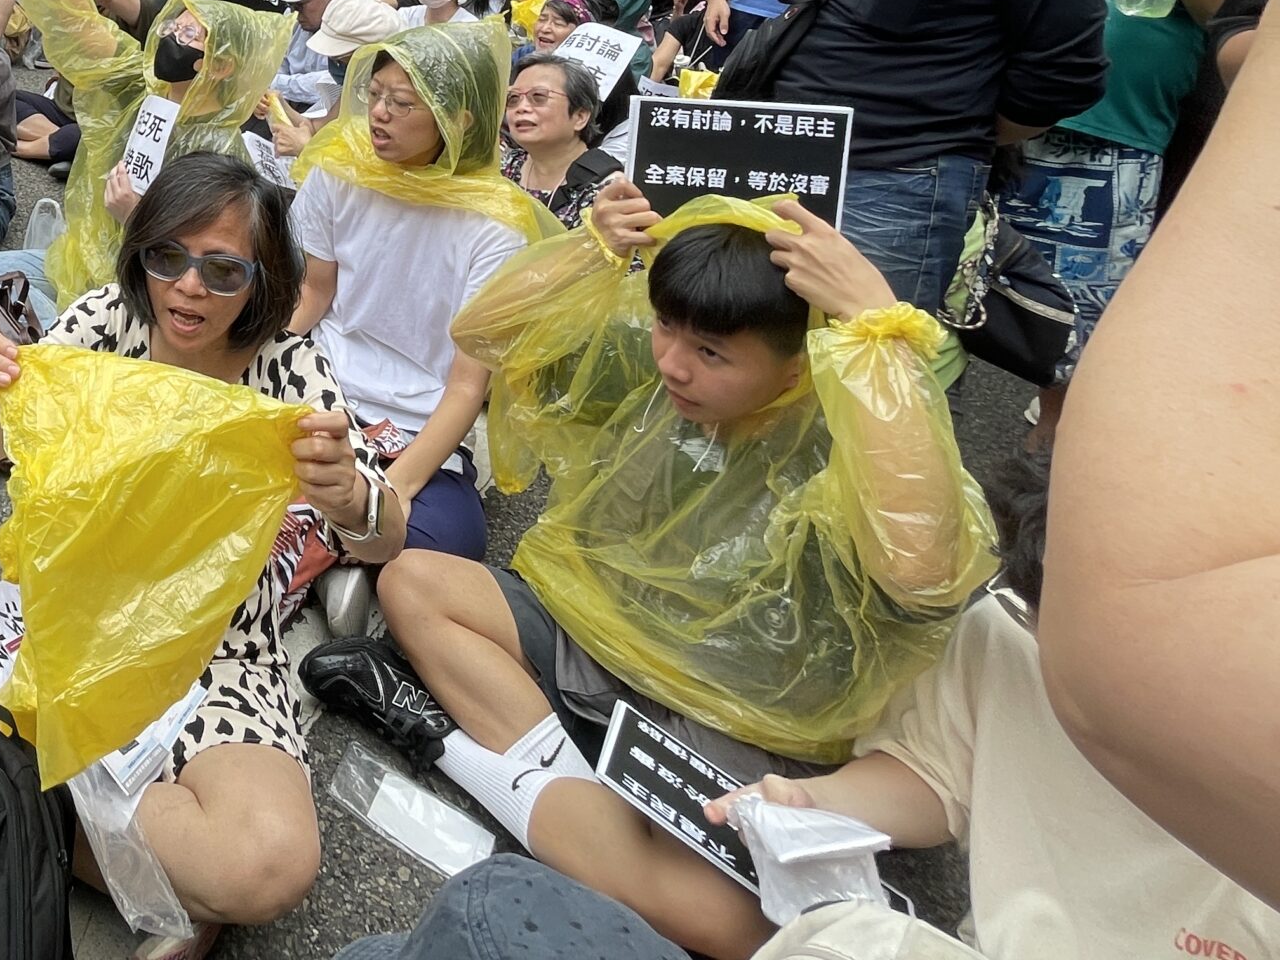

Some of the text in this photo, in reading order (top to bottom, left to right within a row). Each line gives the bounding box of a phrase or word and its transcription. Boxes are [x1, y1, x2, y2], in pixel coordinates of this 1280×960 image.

[650, 106, 836, 138] 沒有討論，不是民主
[644, 163, 831, 196] 全案保留，等於沒審
